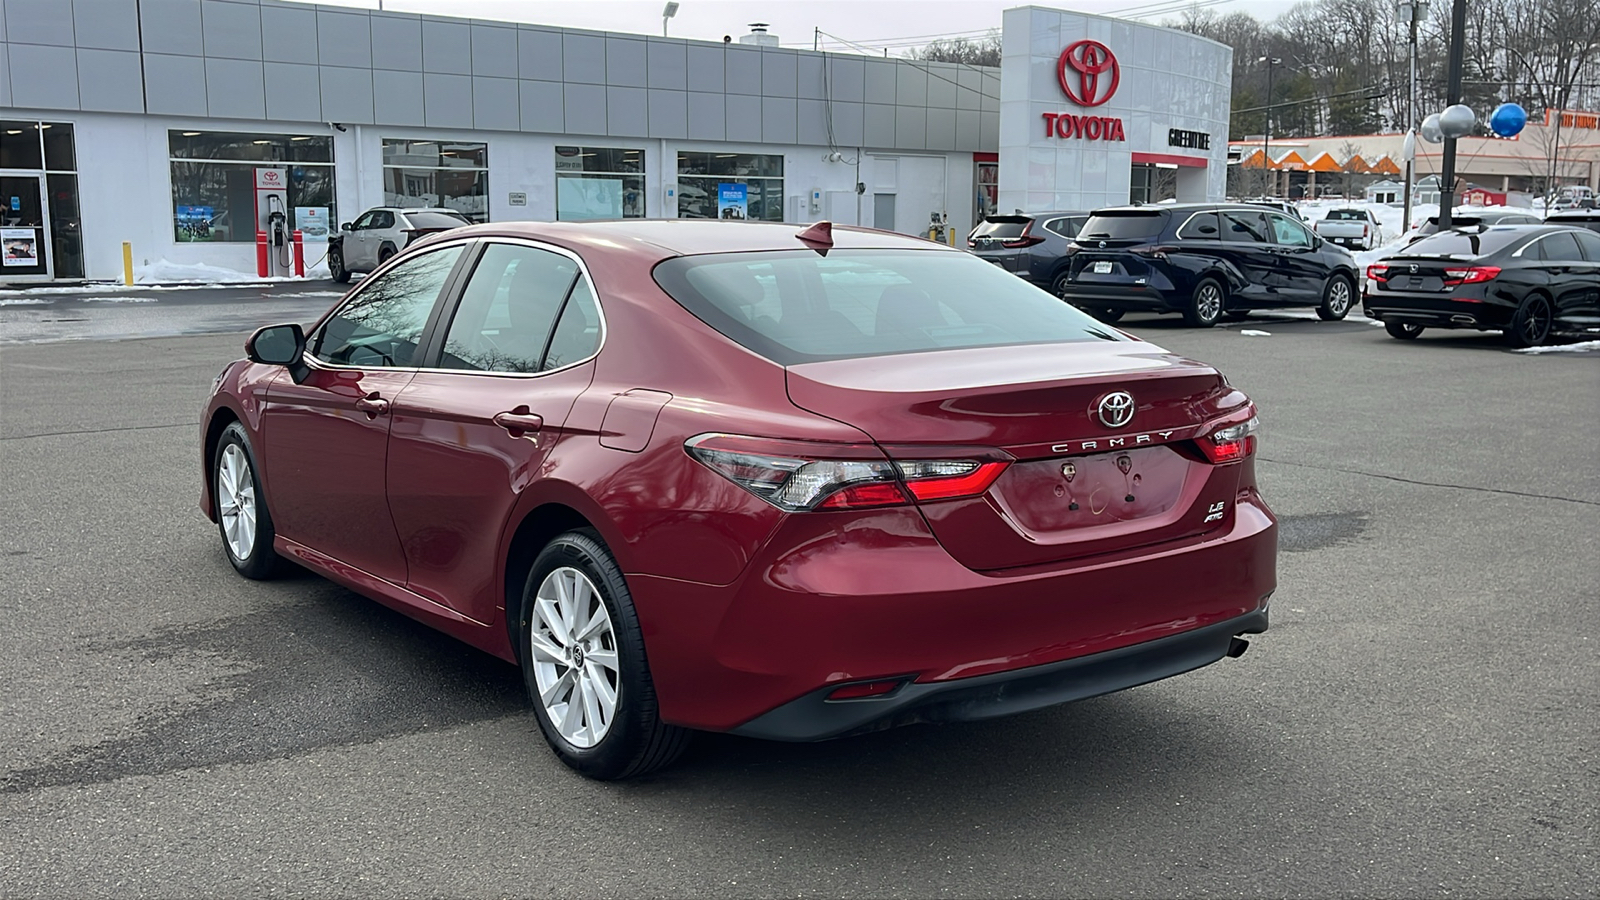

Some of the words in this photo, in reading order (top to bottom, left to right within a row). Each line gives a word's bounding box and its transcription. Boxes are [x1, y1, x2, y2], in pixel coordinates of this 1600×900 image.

[1042, 113, 1125, 141] TOYOTA
[1051, 431, 1173, 452] CAMRY
[1208, 501, 1225, 513] LE
